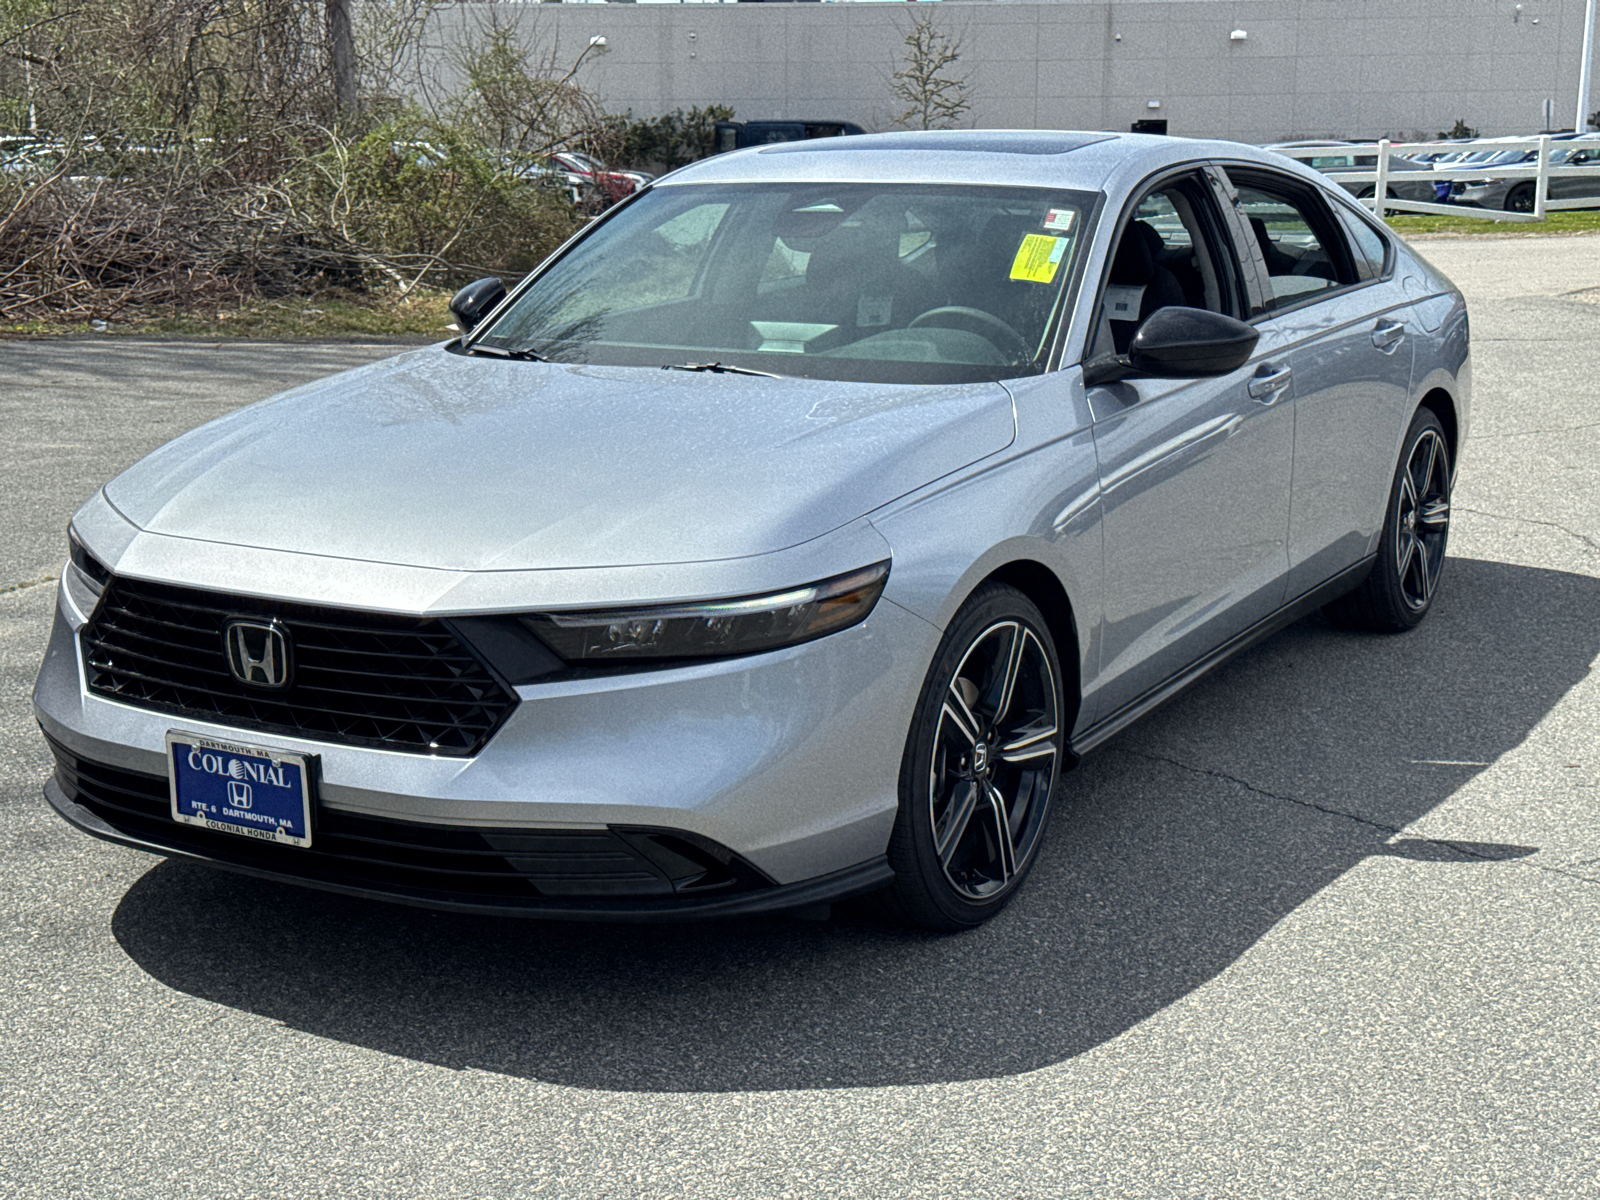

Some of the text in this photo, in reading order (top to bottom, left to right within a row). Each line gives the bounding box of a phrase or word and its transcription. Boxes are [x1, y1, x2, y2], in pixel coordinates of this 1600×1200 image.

[256, 750, 270, 758] MA
[191, 800, 293, 828] RTE. 6 DARTMOUTH, MA
[206, 820, 276, 840] COLONIAL HONDA
